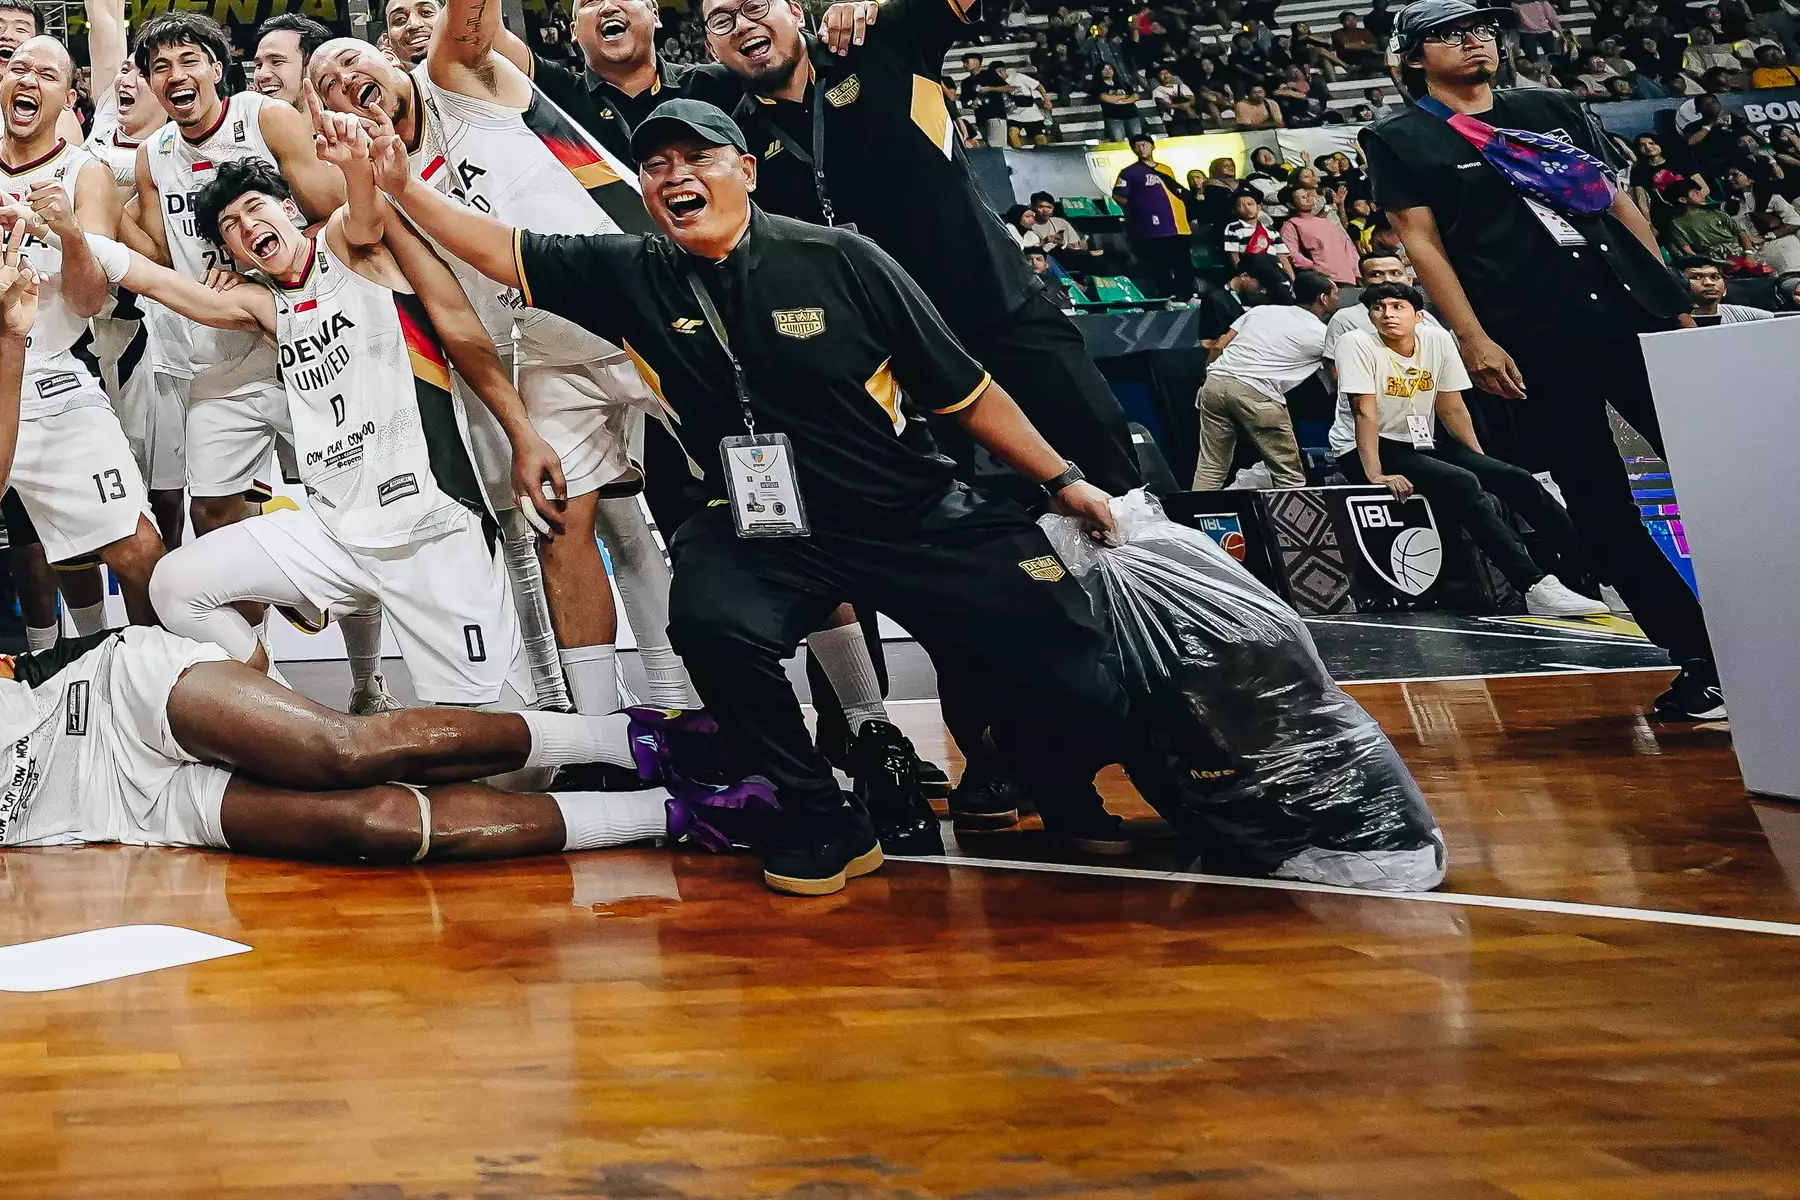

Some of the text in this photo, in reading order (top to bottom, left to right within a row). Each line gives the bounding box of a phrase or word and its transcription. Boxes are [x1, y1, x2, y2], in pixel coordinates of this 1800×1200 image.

[778, 311, 820, 323] DEWA
[786, 323, 815, 333] UNITED
[280, 310, 356, 368] DEWA
[295, 344, 350, 391] UNITED
[306, 450, 323, 466] COW
[327, 439, 343, 456] PLAY
[92, 468, 127, 504] 13
[1204, 517, 1226, 532] IBL
[1357, 505, 1404, 528] IBL
[1023, 557, 1057, 571] DEWA
[463, 624, 487, 662] 0
[0, 791, 17, 812] PLAY
[12, 764, 27, 788] COW
